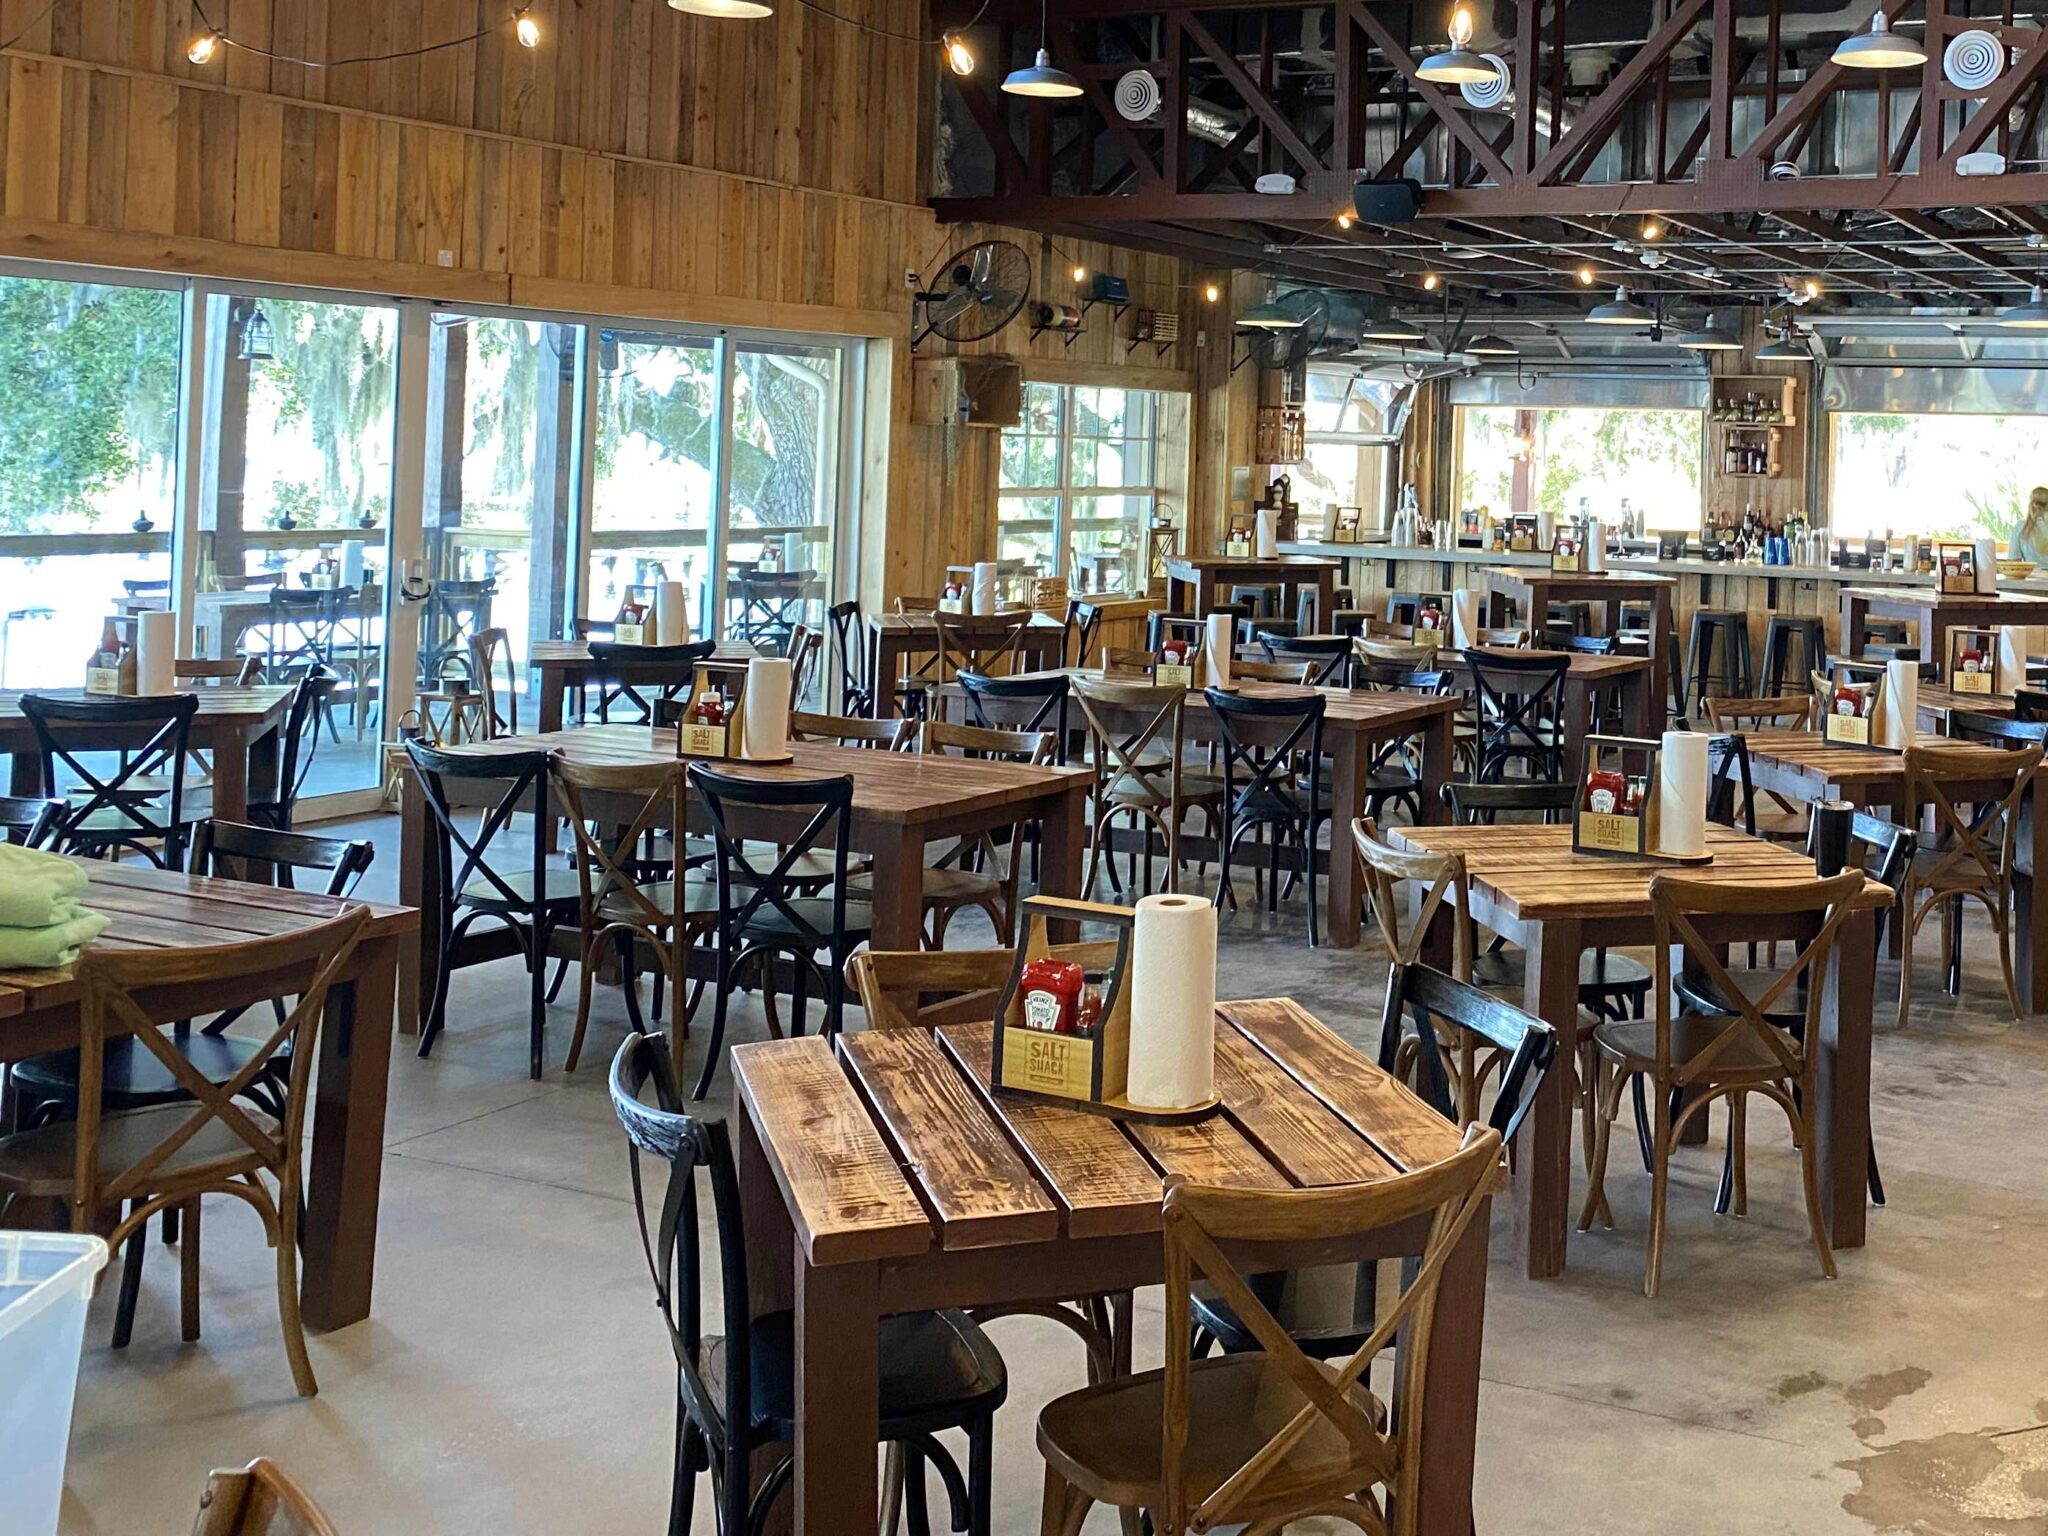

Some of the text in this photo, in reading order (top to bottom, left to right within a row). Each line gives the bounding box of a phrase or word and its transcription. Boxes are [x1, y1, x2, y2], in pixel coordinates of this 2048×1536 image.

[694, 729, 710, 738] SALT
[1598, 819, 1621, 831] SALT
[1032, 996, 1049, 1005] HEINZ
[1030, 1041, 1066, 1062] SALT
[1029, 1058, 1064, 1076] SHACK
